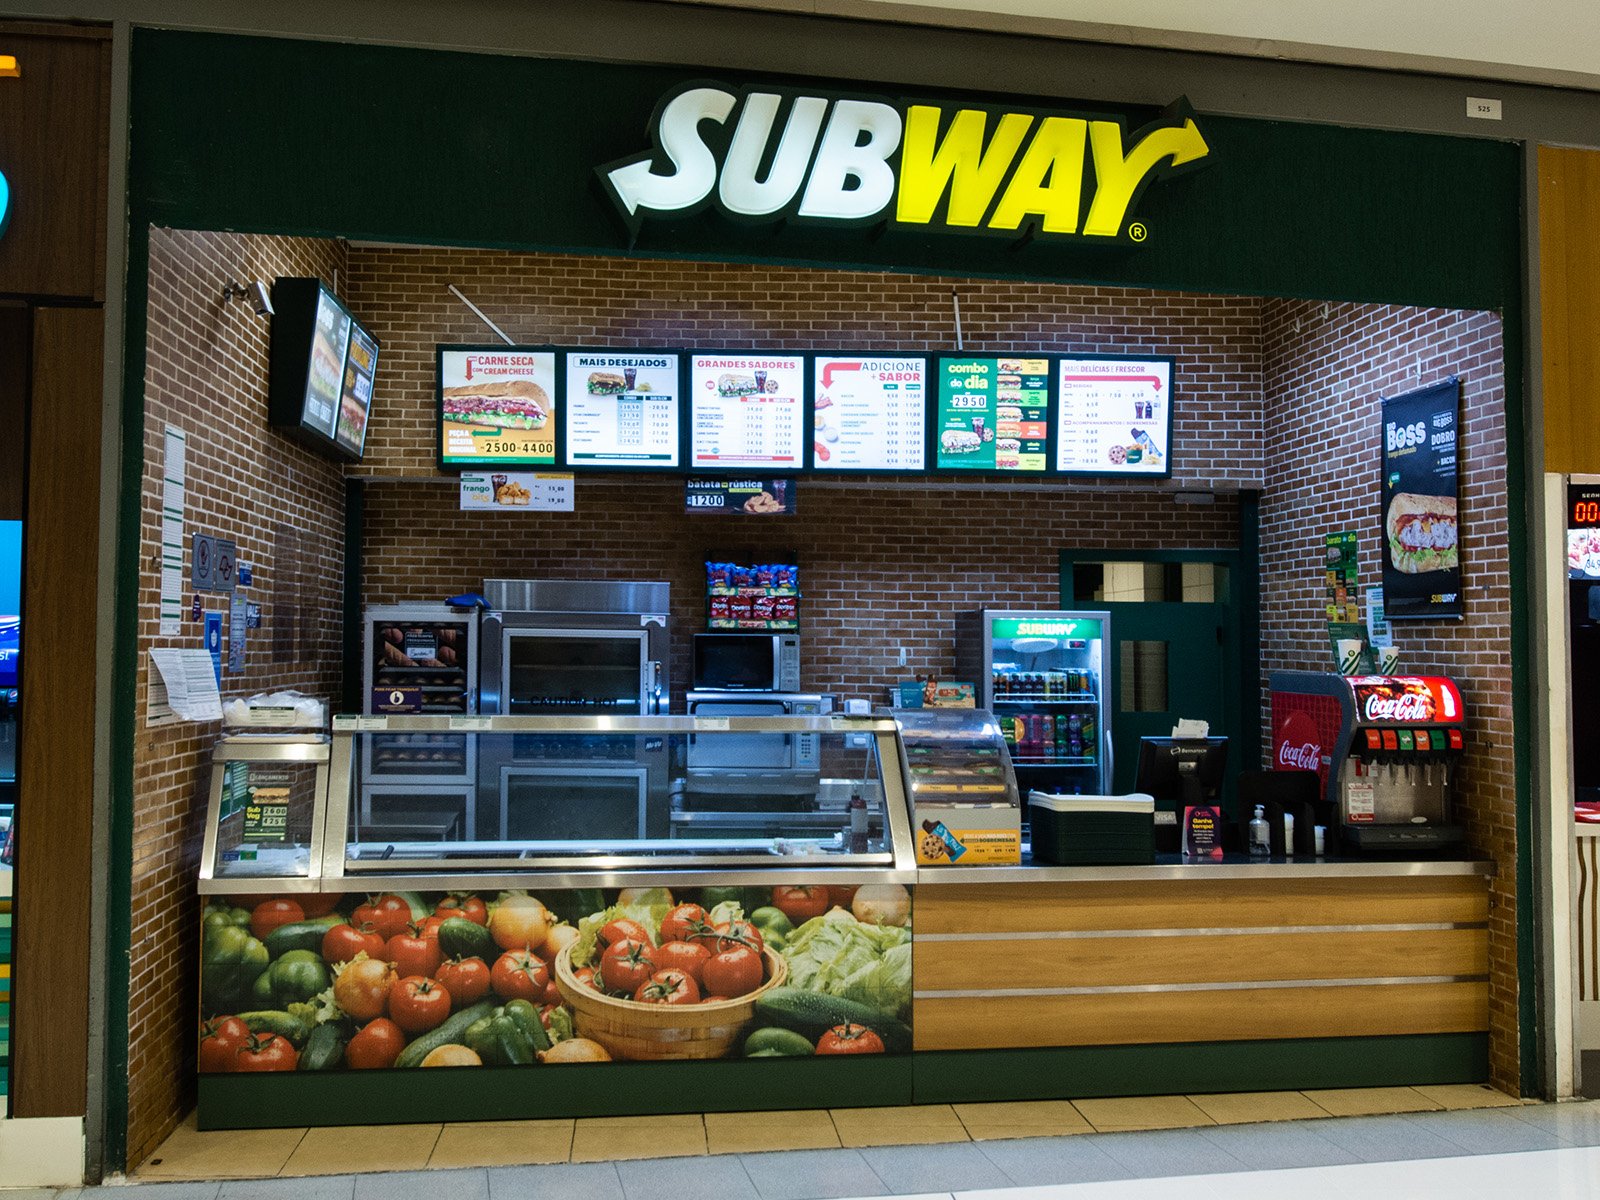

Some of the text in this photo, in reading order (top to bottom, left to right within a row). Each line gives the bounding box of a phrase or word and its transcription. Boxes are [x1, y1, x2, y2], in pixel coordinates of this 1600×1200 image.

[607, 87, 1209, 236] SUBWAY
[478, 357, 534, 366] CARNE SECA
[580, 358, 667, 367] MAIS DESEJADOS
[697, 360, 795, 369] GRANDES SABORES
[862, 362, 921, 371] ADICIONE
[484, 368, 508, 376] CREAM
[948, 362, 988, 373] combo
[1065, 365, 1079, 373] MAIS
[1081, 364, 1109, 373] DELÍCIAS
[1116, 366, 1145, 374] FRESCOR
[879, 373, 920, 381] SABOR
[950, 375, 988, 389] do dia
[1387, 423, 1427, 451] BOSS
[1431, 430, 1455, 446] DOBRO
[463, 485, 490, 494] frango
[688, 480, 762, 489] batata rústica
[1348, 533, 1356, 543] dia
[1431, 593, 1457, 603] SUBWAY
[1016, 623, 1077, 635] SUBWAY
[531, 696, 587, 706] CAUTION
[1366, 694, 1428, 721] Coca-Cola
[1279, 740, 1321, 772] Coca-Cola
